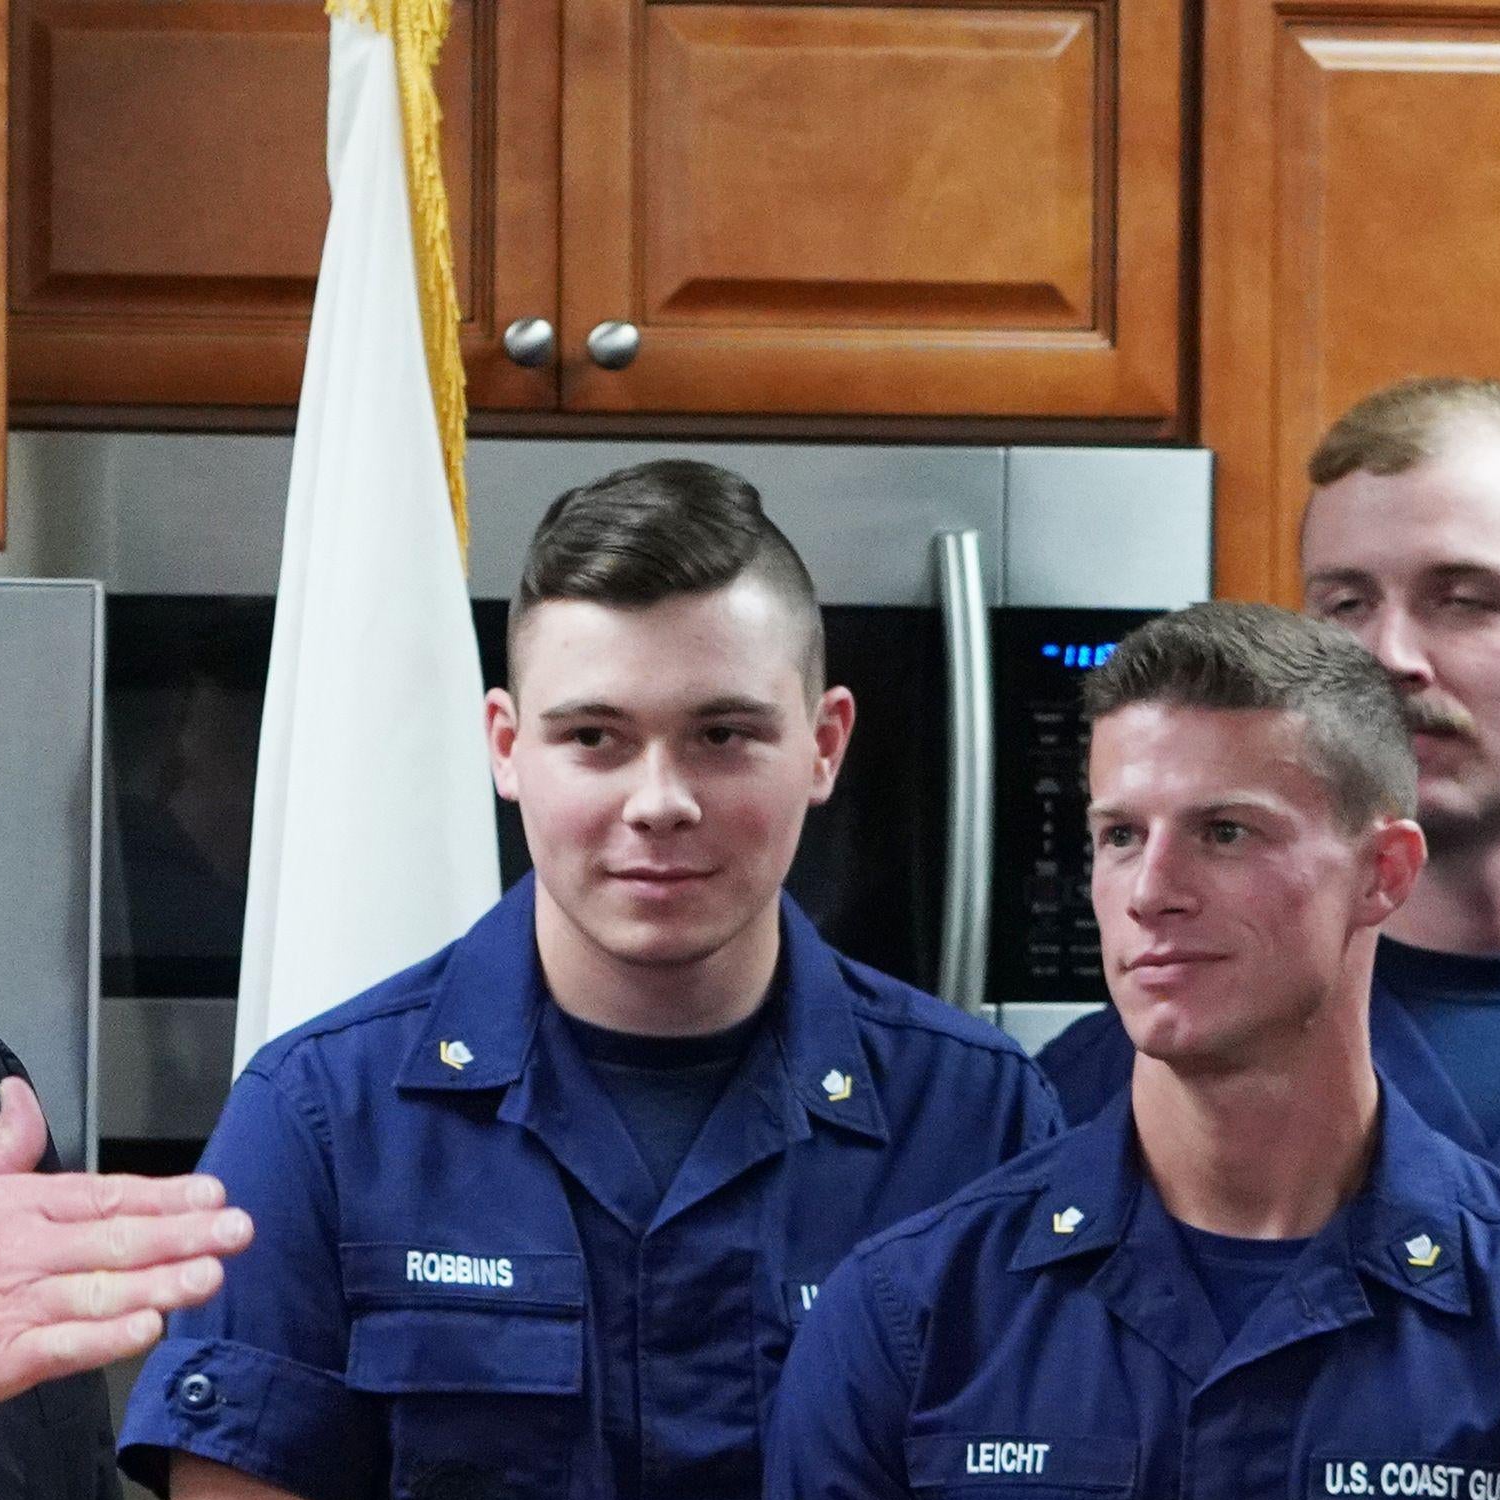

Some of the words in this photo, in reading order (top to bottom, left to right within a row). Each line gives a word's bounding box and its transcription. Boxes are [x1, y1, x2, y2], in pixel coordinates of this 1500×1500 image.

[406, 1250, 514, 1287] ROBBINS
[966, 1442, 1050, 1474] LEICHT
[1325, 1461, 1375, 1495] U.S.
[1380, 1462, 1465, 1499] COAST
